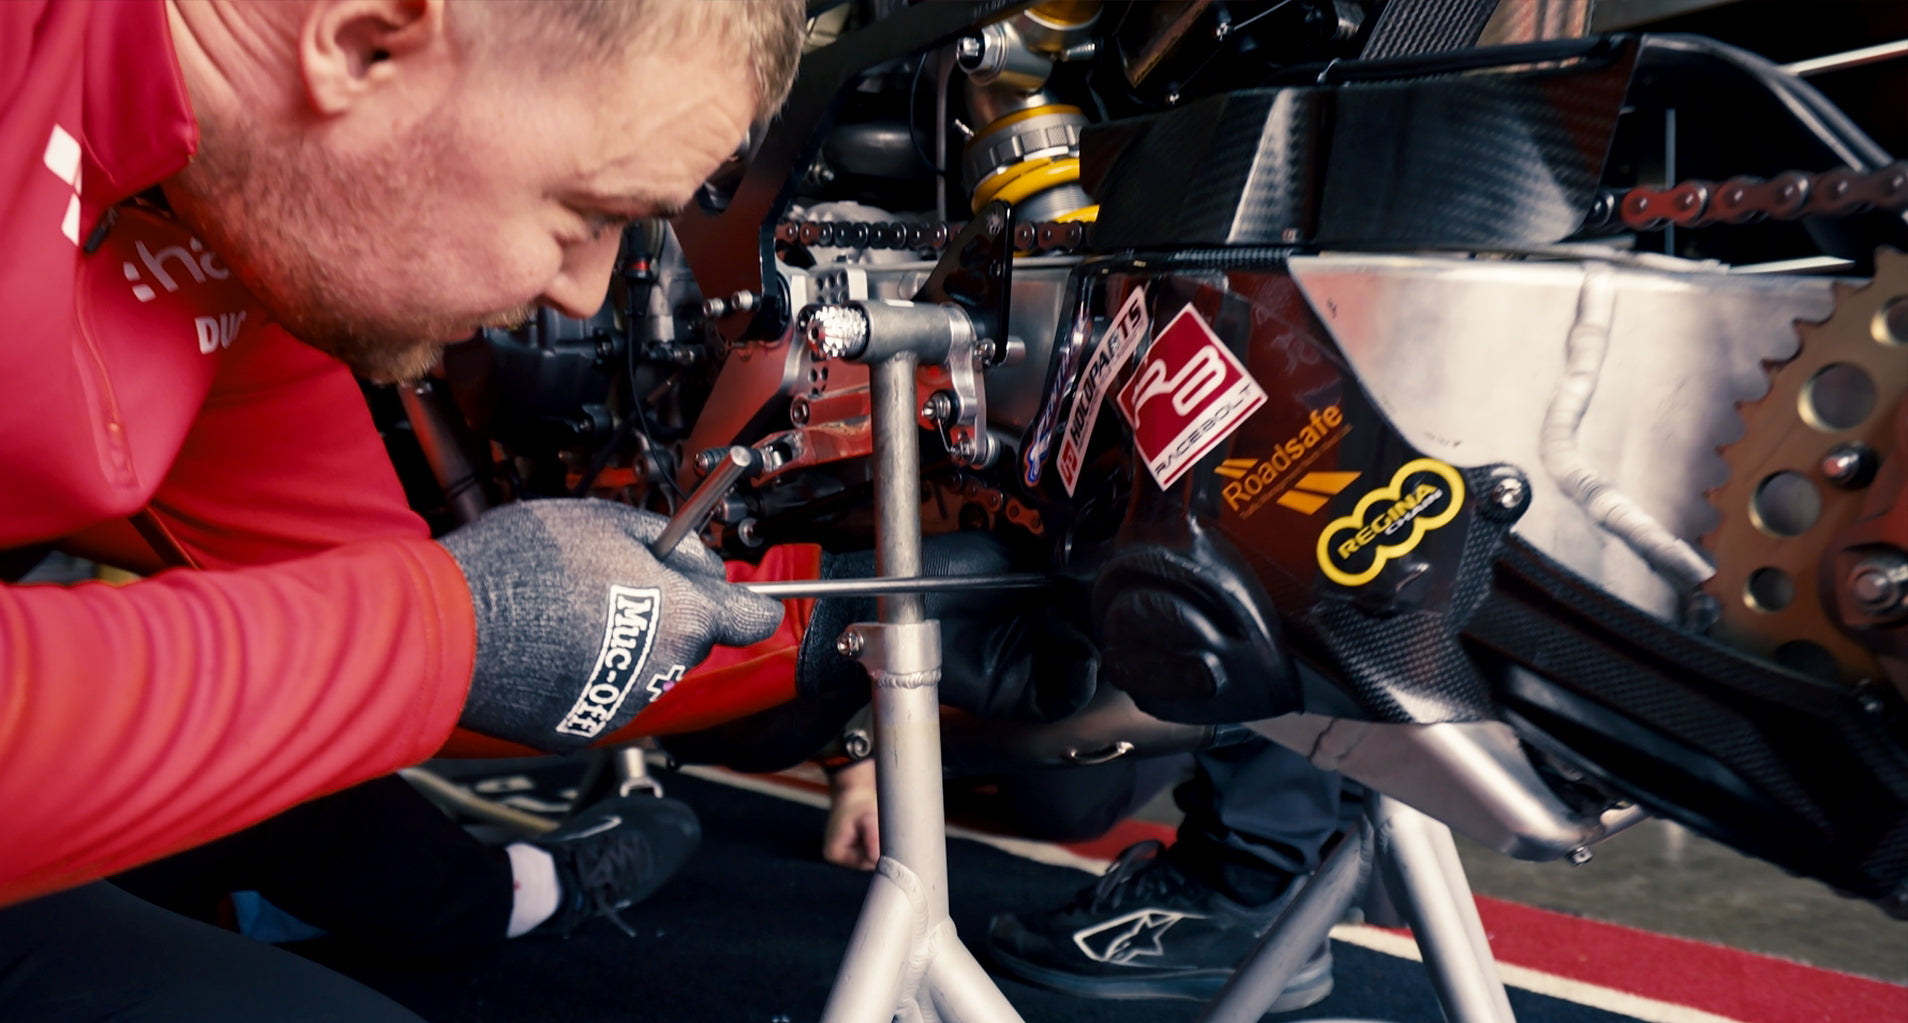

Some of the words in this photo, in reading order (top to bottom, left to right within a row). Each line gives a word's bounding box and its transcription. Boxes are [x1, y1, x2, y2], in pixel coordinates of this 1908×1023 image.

[1155, 382, 1252, 477] RACEBOLT
[1221, 404, 1344, 512] Roadsafe
[1337, 483, 1438, 560] REGINA
